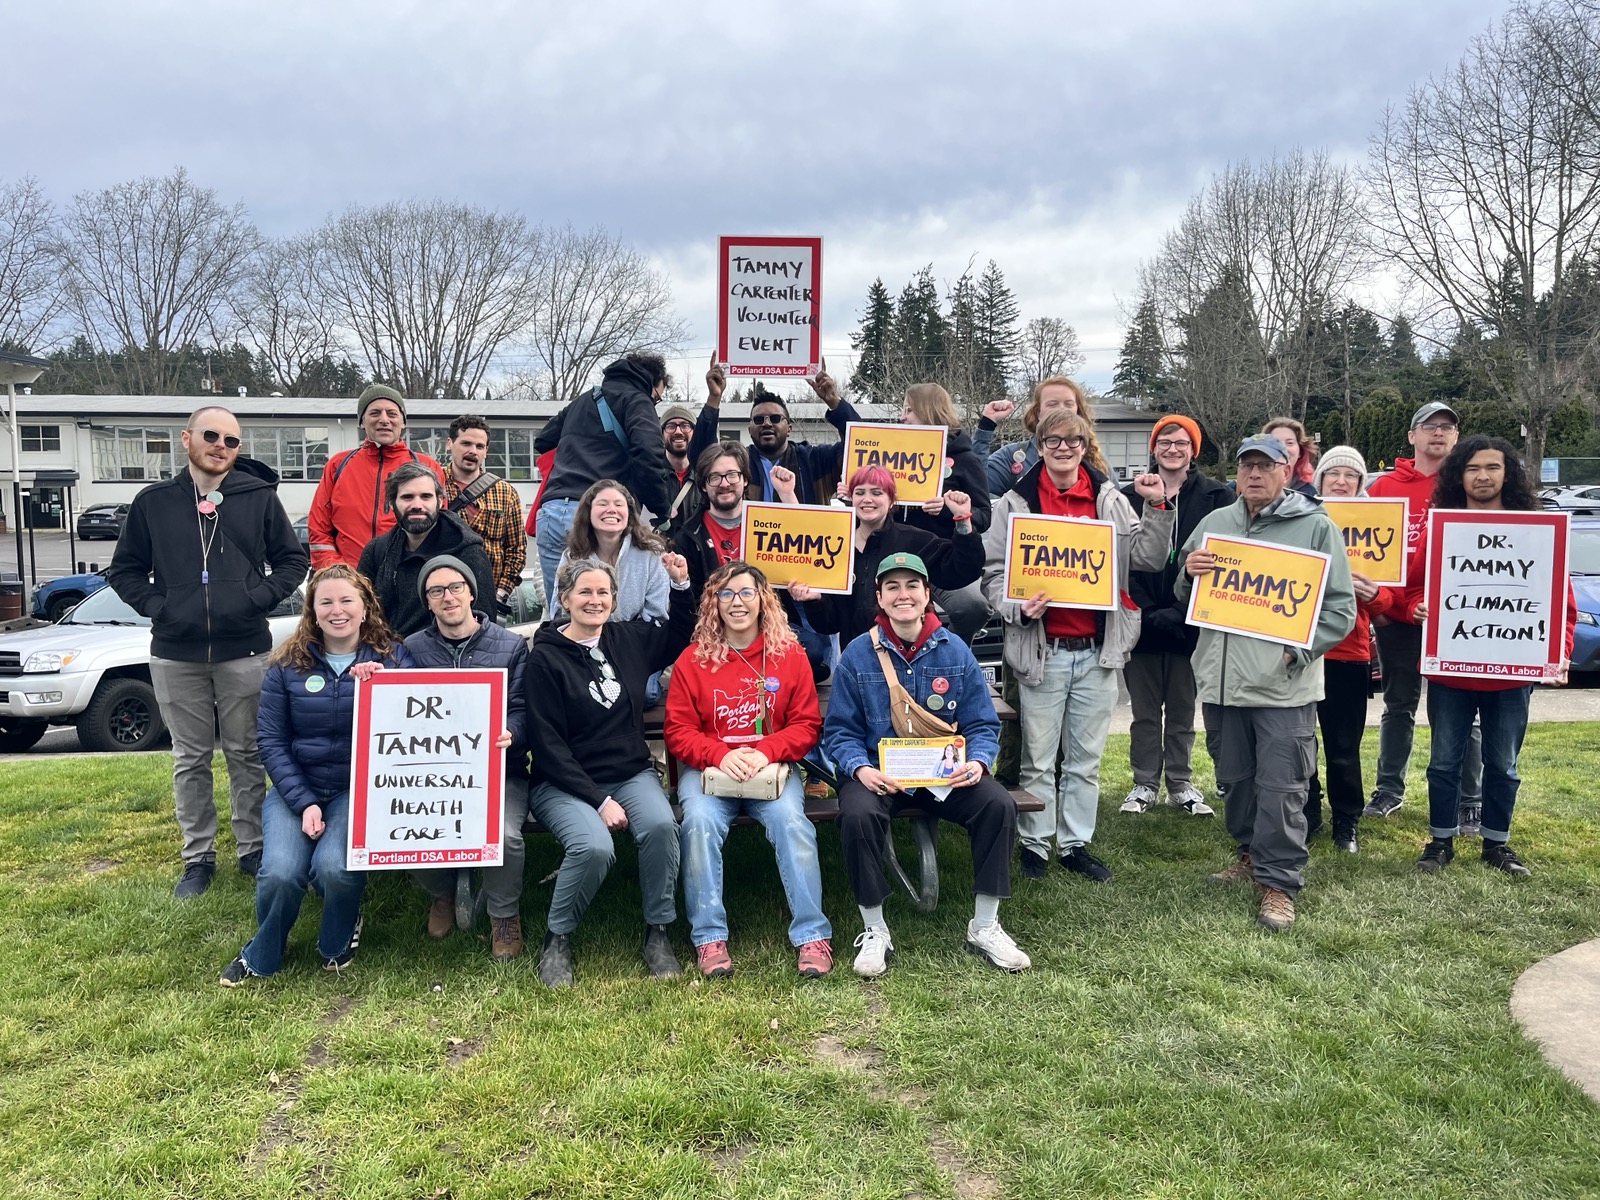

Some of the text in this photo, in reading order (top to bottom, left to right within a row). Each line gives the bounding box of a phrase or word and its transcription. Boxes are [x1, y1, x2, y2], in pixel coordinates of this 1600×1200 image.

[732, 256, 803, 279] TAMMY
[731, 283, 819, 305] CARPENTER
[738, 306, 819, 332] VOLUNTEER
[738, 337, 799, 354] EVENT
[731, 367, 805, 376] Portland DSA Labor
[855, 439, 880, 447] Doctor
[855, 449, 935, 484] TAMMY
[753, 520, 781, 529] Doctor
[1020, 532, 1049, 542] Doctor
[1477, 534, 1513, 550] DR.
[753, 531, 844, 569] TAMMY
[756, 553, 812, 565] FOR OREGON
[1211, 553, 1242, 566] Doctor
[1019, 544, 1106, 585] TAMMY
[1022, 567, 1079, 579] FOR OREGON
[1447, 555, 1535, 580] TAMMY
[1209, 589, 1271, 609] FOR OREGON
[1211, 565, 1312, 618] TAMMY
[1444, 594, 1542, 614] CLIMATE
[1451, 620, 1545, 642] ACTION!
[1442, 662, 1541, 677] Portland DSA Labor
[406, 696, 451, 720] DR.
[373, 732, 482, 756] TAMMY
[374, 773, 483, 789] UNIVERSAL
[390, 798, 463, 816] HEALTH
[371, 851, 479, 864] Portland DSA Labor
